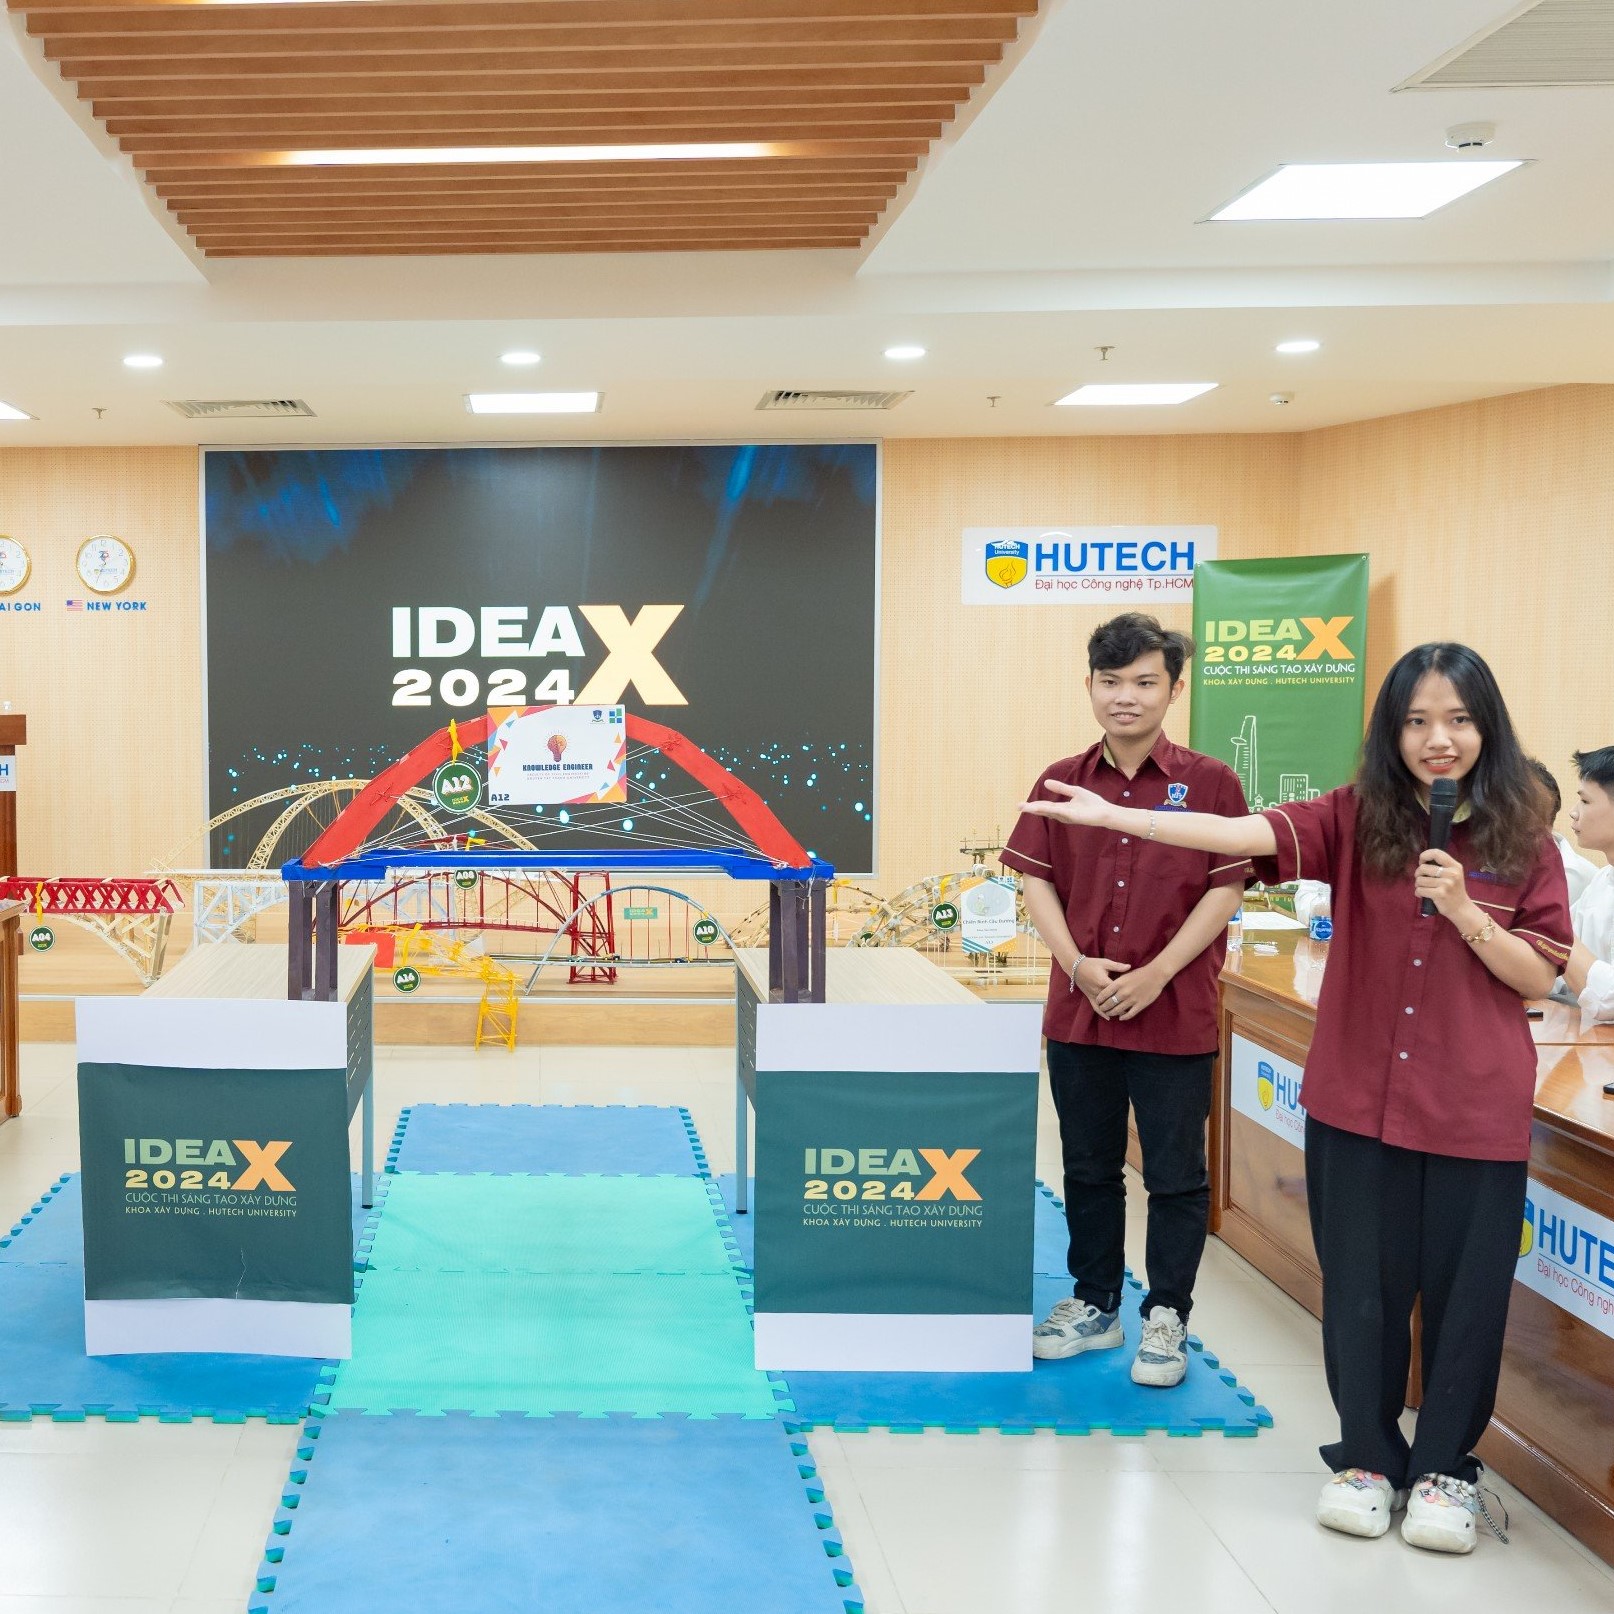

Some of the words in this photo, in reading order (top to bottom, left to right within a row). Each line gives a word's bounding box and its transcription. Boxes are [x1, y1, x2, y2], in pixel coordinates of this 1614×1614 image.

[1036, 542, 1194, 572] HUTECH
[1035, 579, 1053, 591] Đại
[1056, 579, 1078, 591] học
[1082, 578, 1112, 591] Công
[1116, 578, 1143, 591] nghệ
[1147, 578, 1194, 591] Tp.HCM
[87, 602, 112, 611] NEW
[116, 602, 147, 611] YORK
[1204, 645, 1297, 662] 2024
[1204, 666, 1232, 676] CUỘC
[1234, 666, 1250, 675] THI
[1253, 664, 1278, 675] SÁNG
[1280, 664, 1301, 675] TẠO
[1276, 677, 1308, 685] HUTECH
[1310, 676, 1355, 684] UNIVERSITY
[392, 669, 574, 706] 2024
[522, 764, 560, 772] KNOWLEDGE
[441, 774, 473, 795] A12
[491, 794, 510, 802] A12
[125, 1170, 232, 1190] 2024
[804, 1180, 915, 1200] 2024
[162, 1193, 178, 1203] THI
[182, 1192, 211, 1204] SÁNG
[125, 1206, 151, 1214] KHOA
[209, 1208, 244, 1216] HUTECH
[248, 1209, 297, 1217] UNIVERSITY
[803, 1203, 838, 1216] CUỘC
[841, 1205, 859, 1215] THI
[862, 1204, 893, 1215] SÁNG
[896, 1205, 921, 1216] TẠO
[803, 1218, 830, 1226] KHOA
[890, 1219, 927, 1227] HUTECH
[931, 1220, 982, 1228] UNIVERSITY
[1539, 1209, 1614, 1288] HUTE
[1537, 1259, 1551, 1278] Đại
[1553, 1270, 1569, 1288] học
[1571, 1279, 1594, 1306] Công
